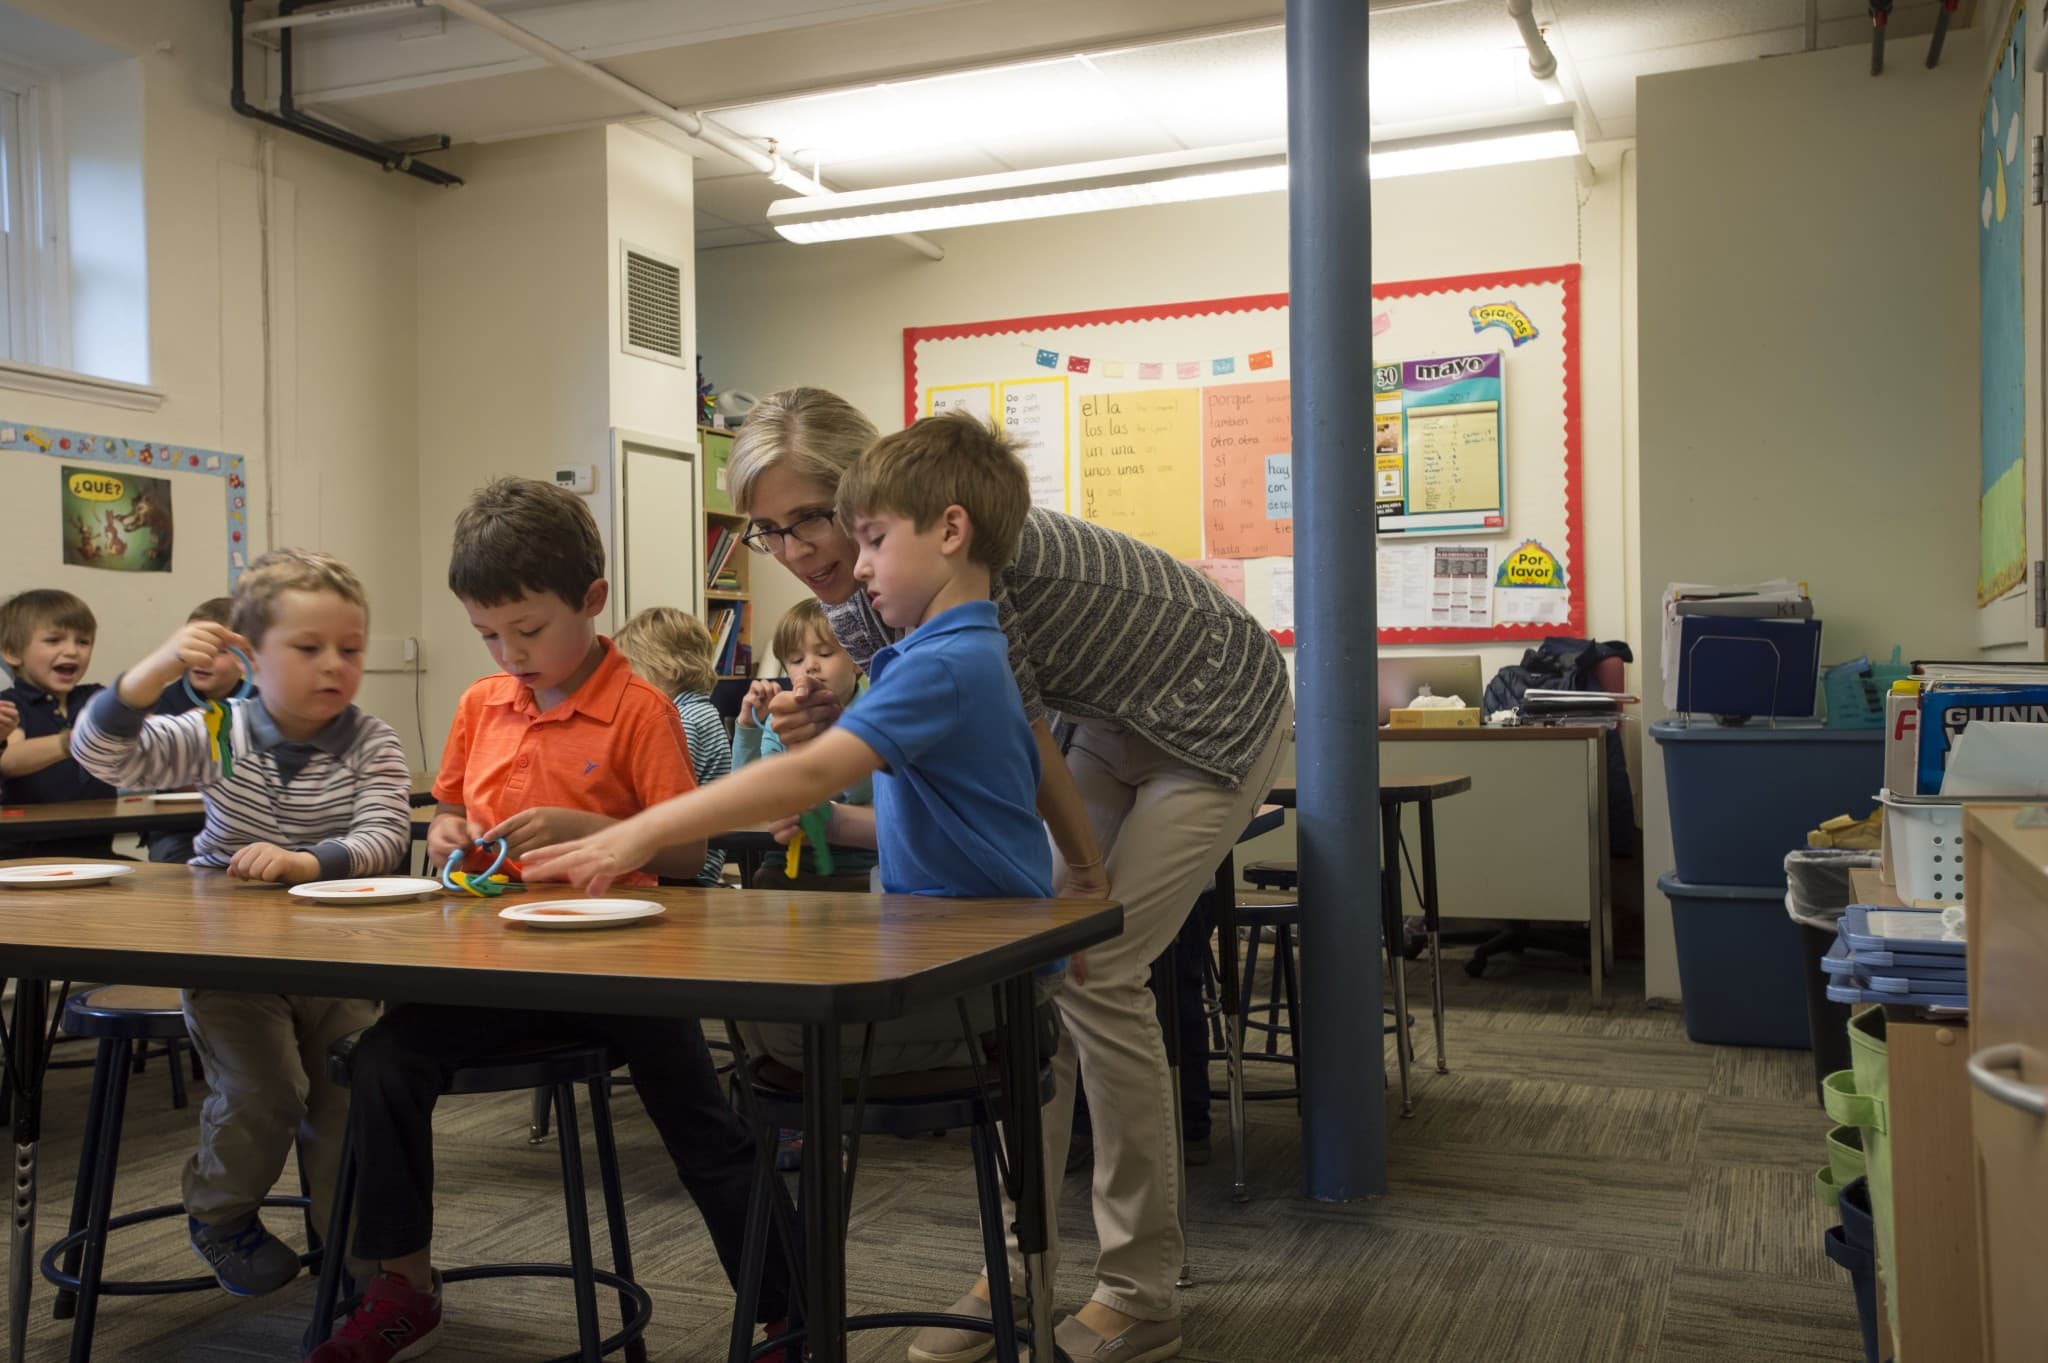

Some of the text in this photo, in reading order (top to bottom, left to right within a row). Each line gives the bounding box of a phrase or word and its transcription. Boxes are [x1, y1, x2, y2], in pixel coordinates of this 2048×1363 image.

[1480, 309, 1527, 334] Gracias
[1416, 357, 1484, 380] mayo
[1376, 367, 1398, 387] 30
[1006, 394, 1019, 402] Oo
[1082, 394, 1098, 416] el
[1106, 394, 1121, 414] la
[1209, 395, 1255, 411] porque
[1006, 406, 1016, 415] Pp
[1006, 417, 1020, 425] Qq
[1084, 419, 1103, 437] los
[1109, 417, 1128, 435] las
[1211, 433, 1234, 448] otro
[1239, 434, 1259, 445] otra
[1086, 446, 1103, 457] un
[1111, 445, 1135, 456] una
[1084, 466, 1111, 477] unos
[1118, 464, 1144, 475] unas
[1268, 458, 1290, 479] hay
[74, 480, 121, 495] ¿QUÉ?
[1268, 484, 1288, 493] con
[1086, 488, 1094, 504] y
[1518, 554, 1544, 566] Por
[1511, 566, 1550, 578] favor
[1894, 710, 1916, 740] F
[379, 1316, 415, 1347] N
